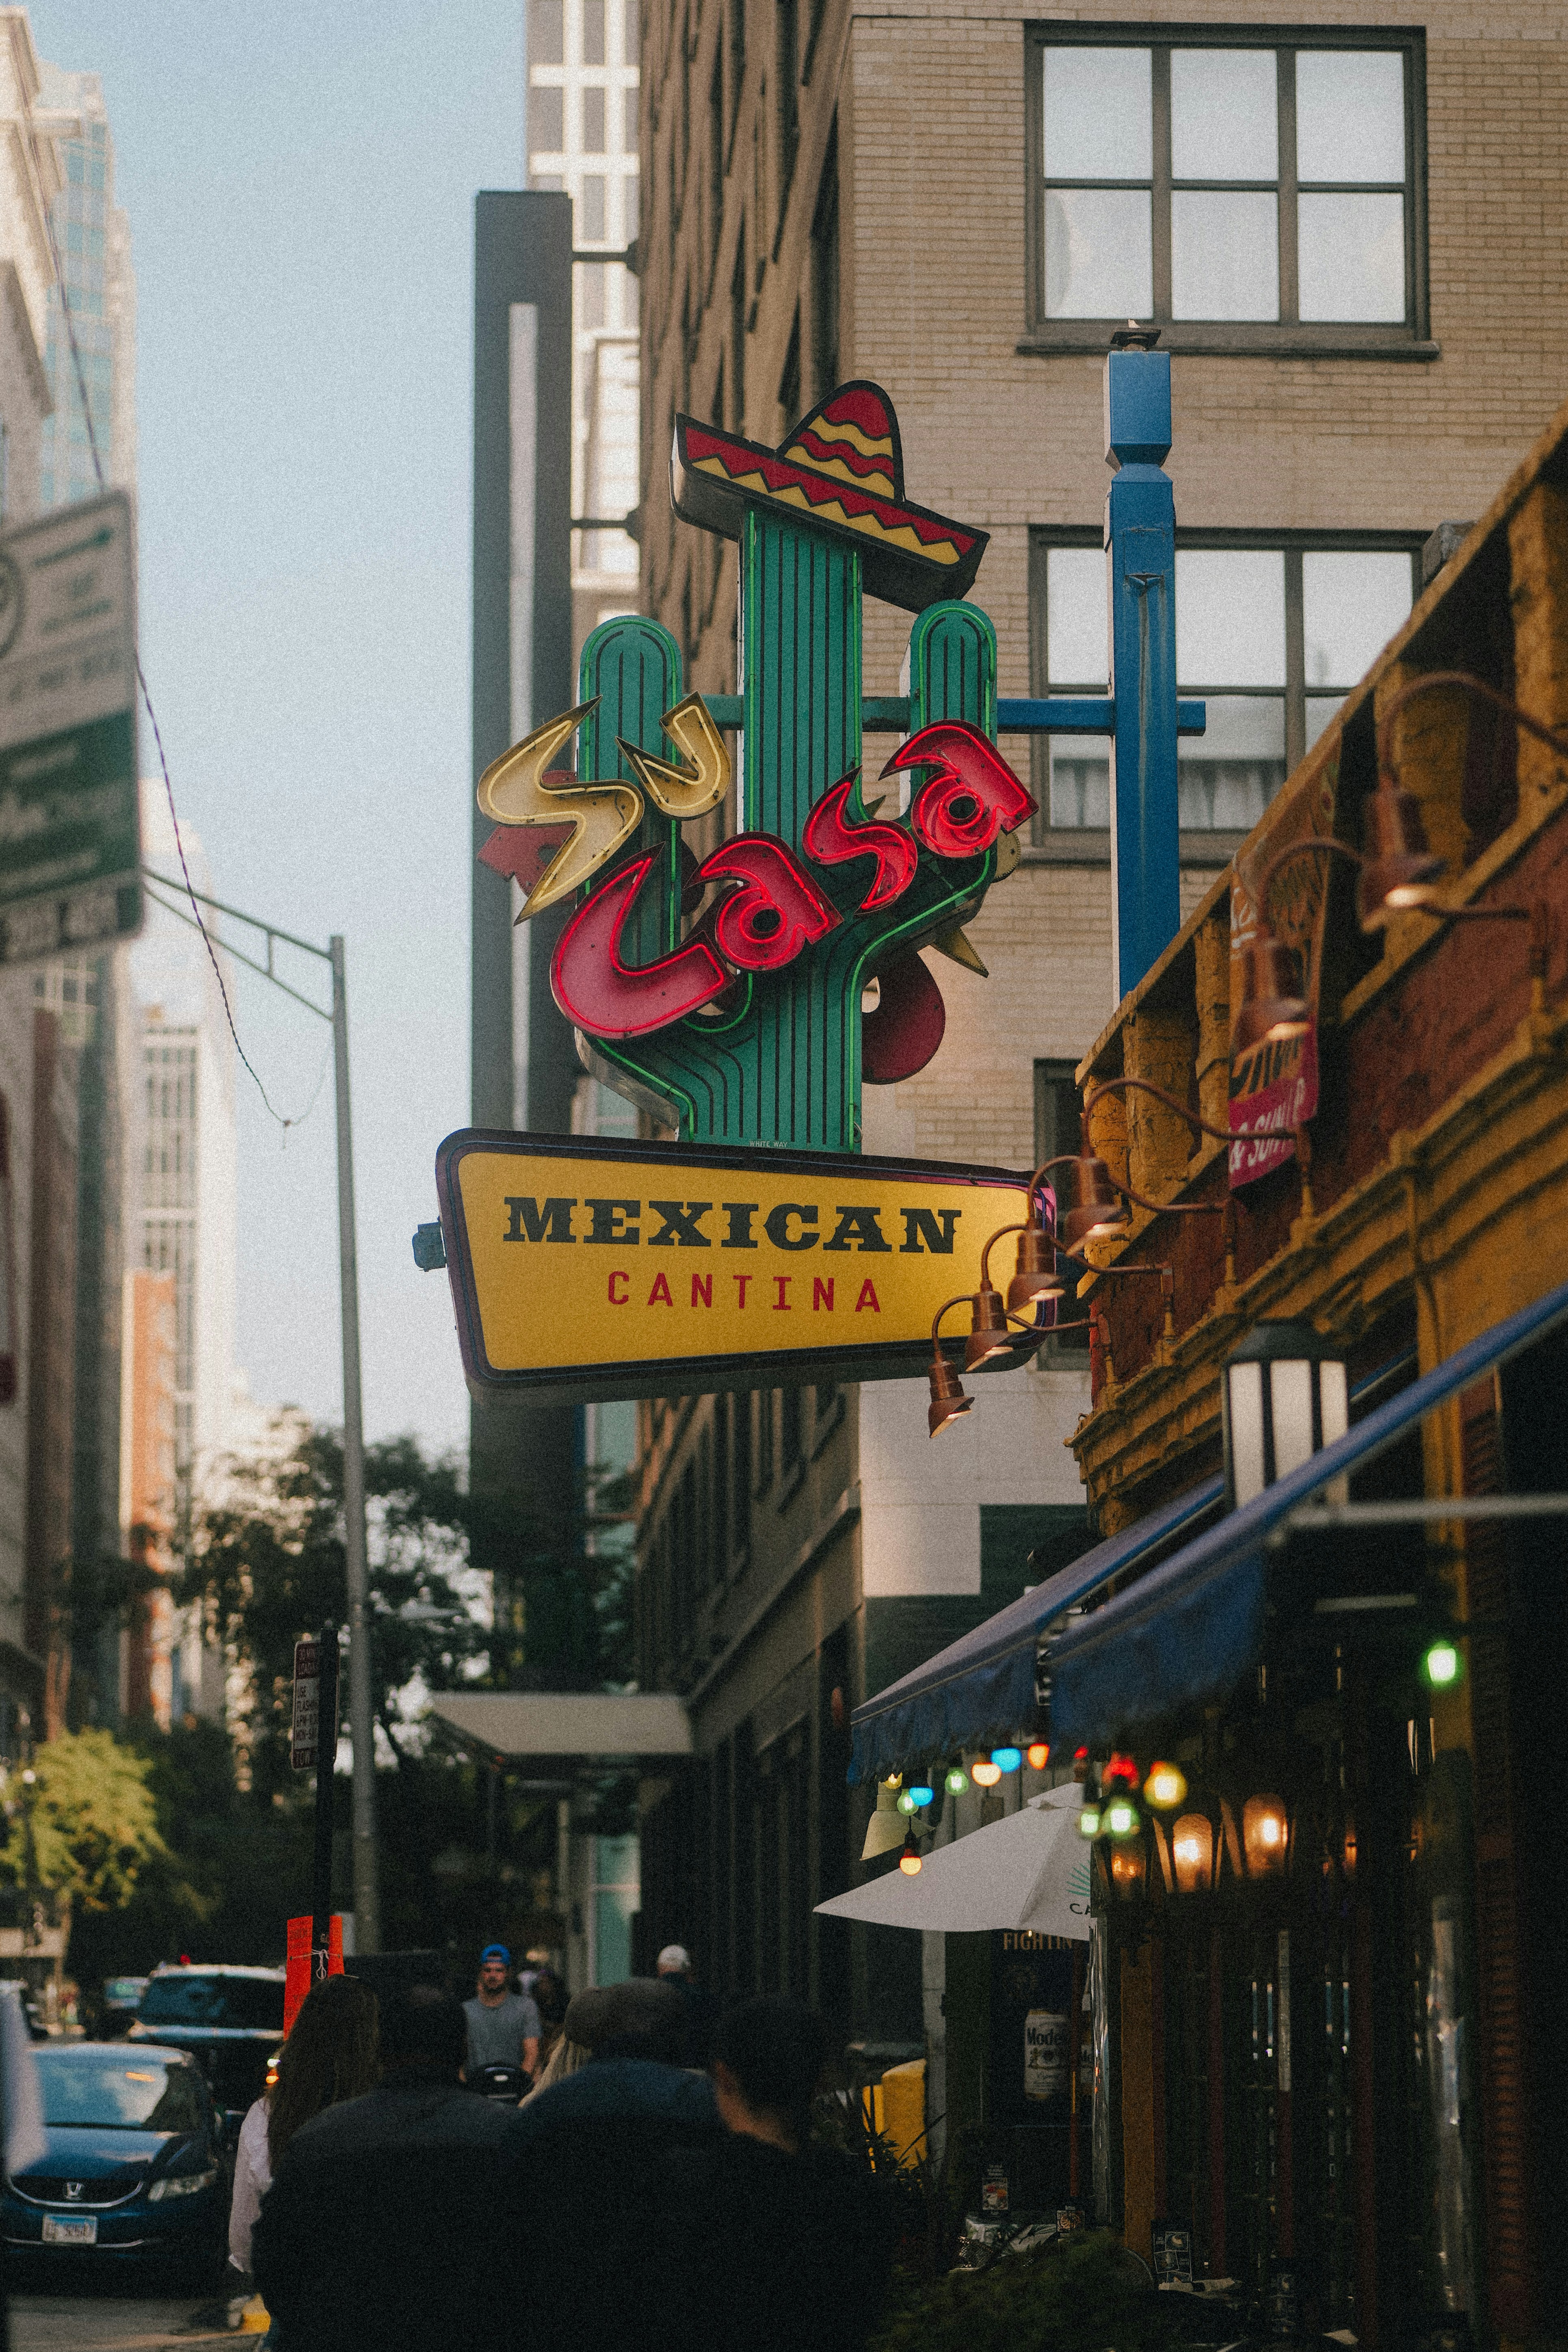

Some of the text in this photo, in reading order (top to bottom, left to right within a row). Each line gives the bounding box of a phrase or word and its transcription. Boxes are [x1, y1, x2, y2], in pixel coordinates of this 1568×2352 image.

[477, 690, 731, 926] Su
[550, 719, 1040, 1040] Casa
[503, 1197, 962, 1254] MEXICAN
[608, 1271, 881, 1313] CANTINA
